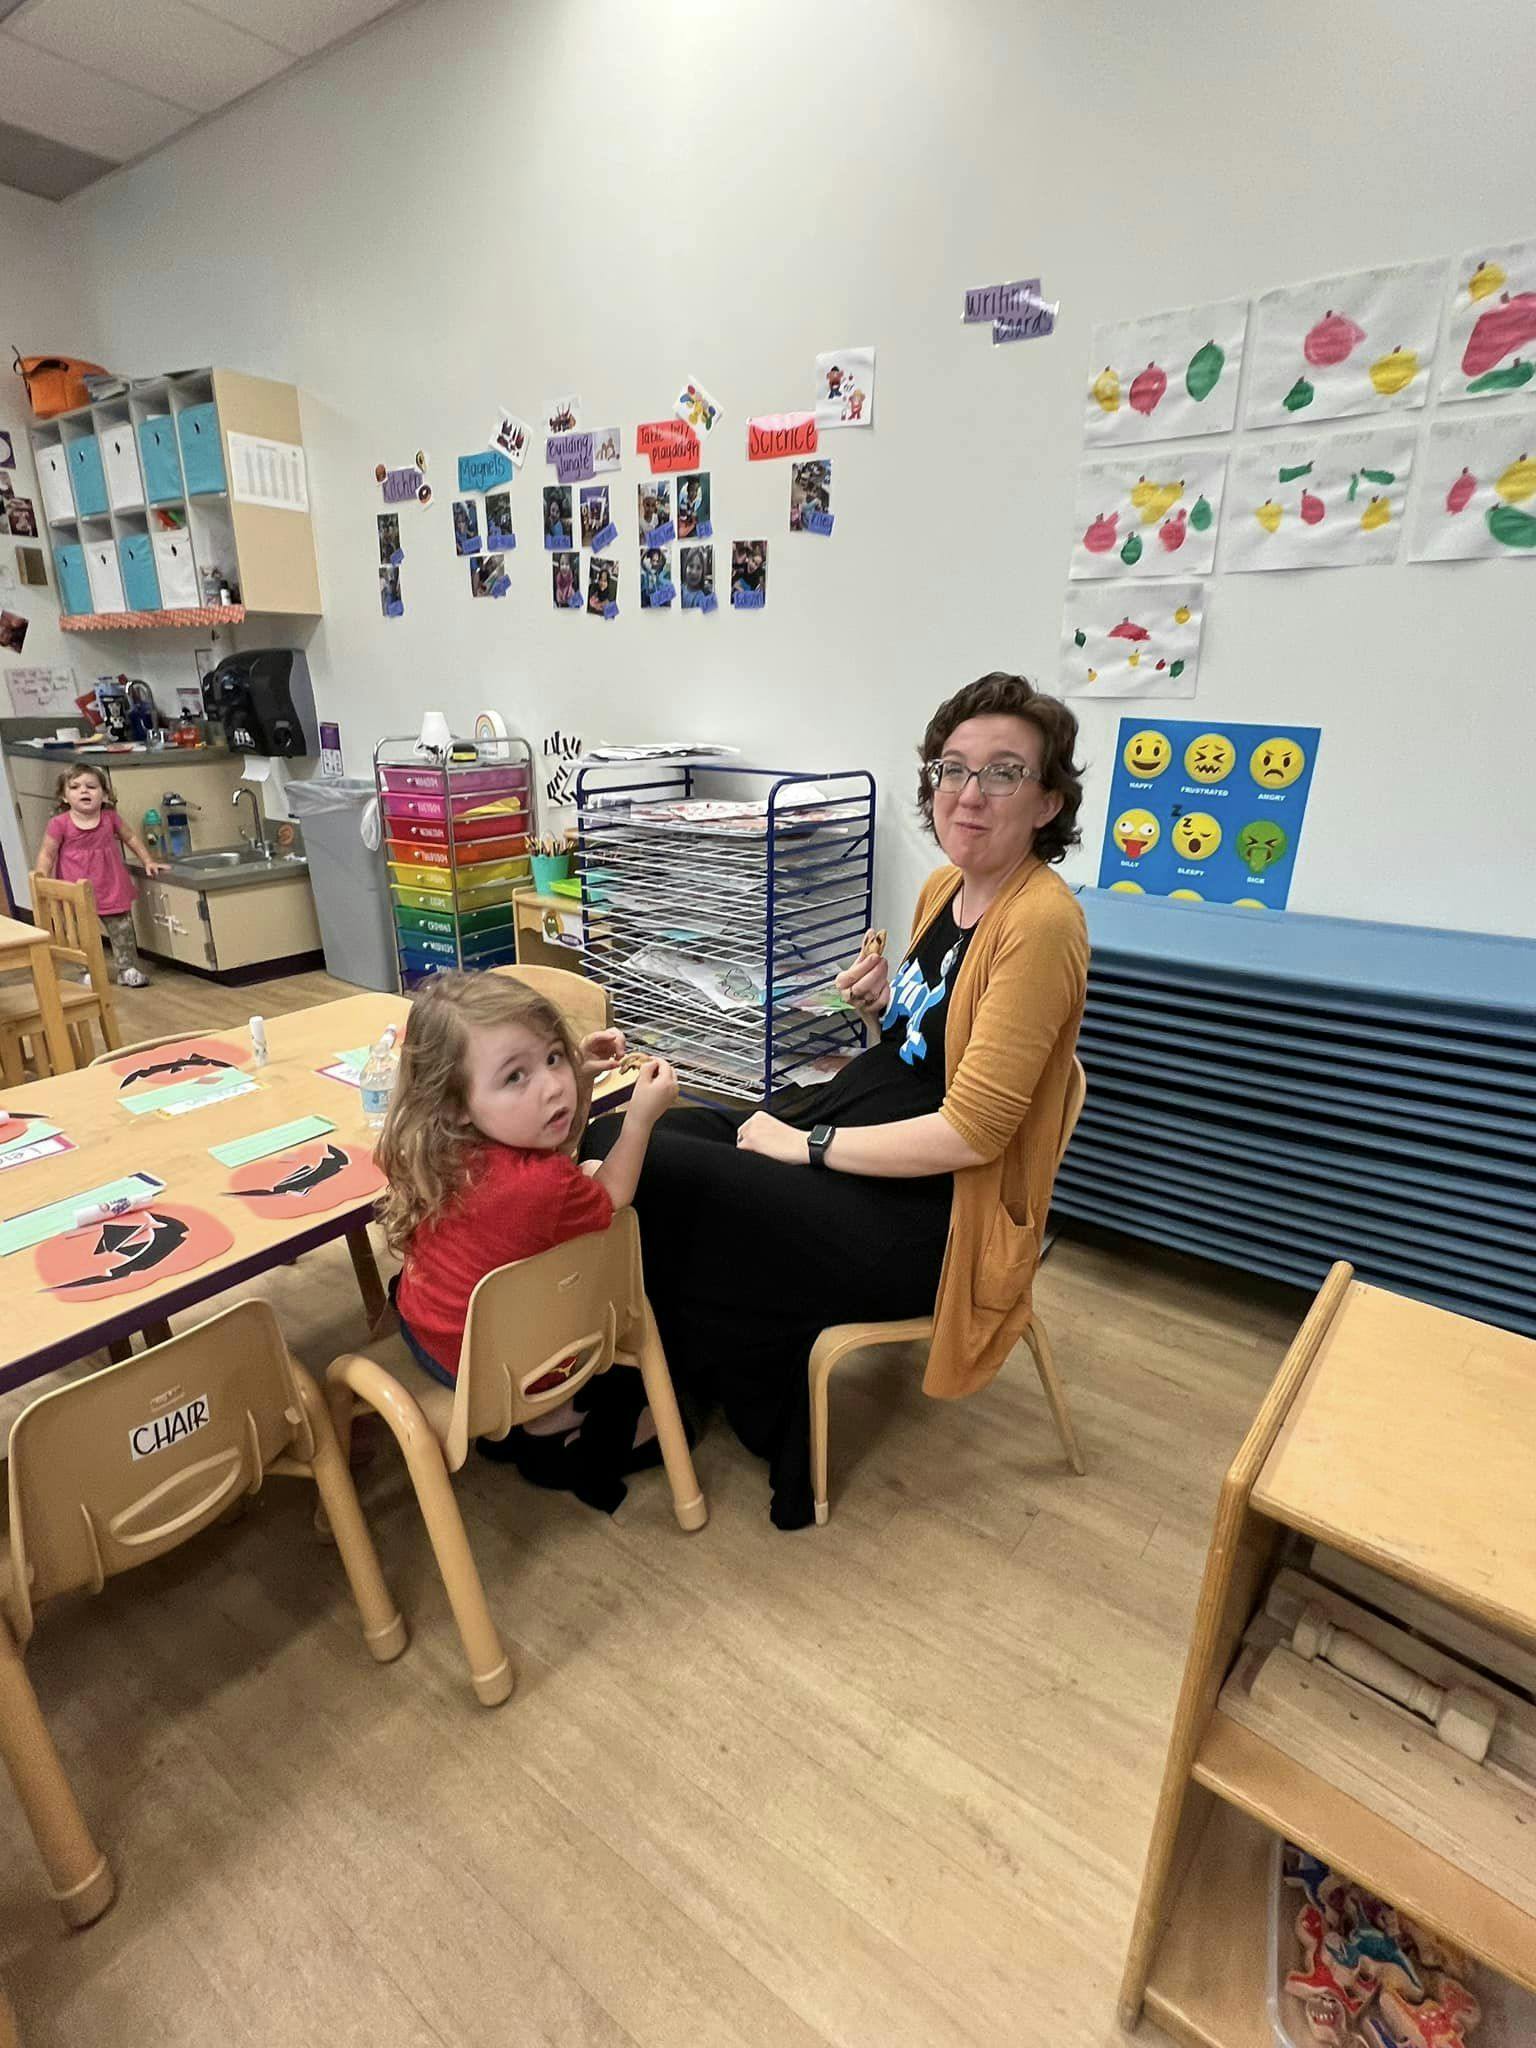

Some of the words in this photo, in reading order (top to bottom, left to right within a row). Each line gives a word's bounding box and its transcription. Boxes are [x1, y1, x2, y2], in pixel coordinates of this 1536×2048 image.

[1129, 782, 1154, 791] HAPPY
[1180, 785, 1229, 797] FRUSTRATED
[1257, 793, 1286, 802] ANGRY
[133, 1401, 209, 1456] CHAIR
